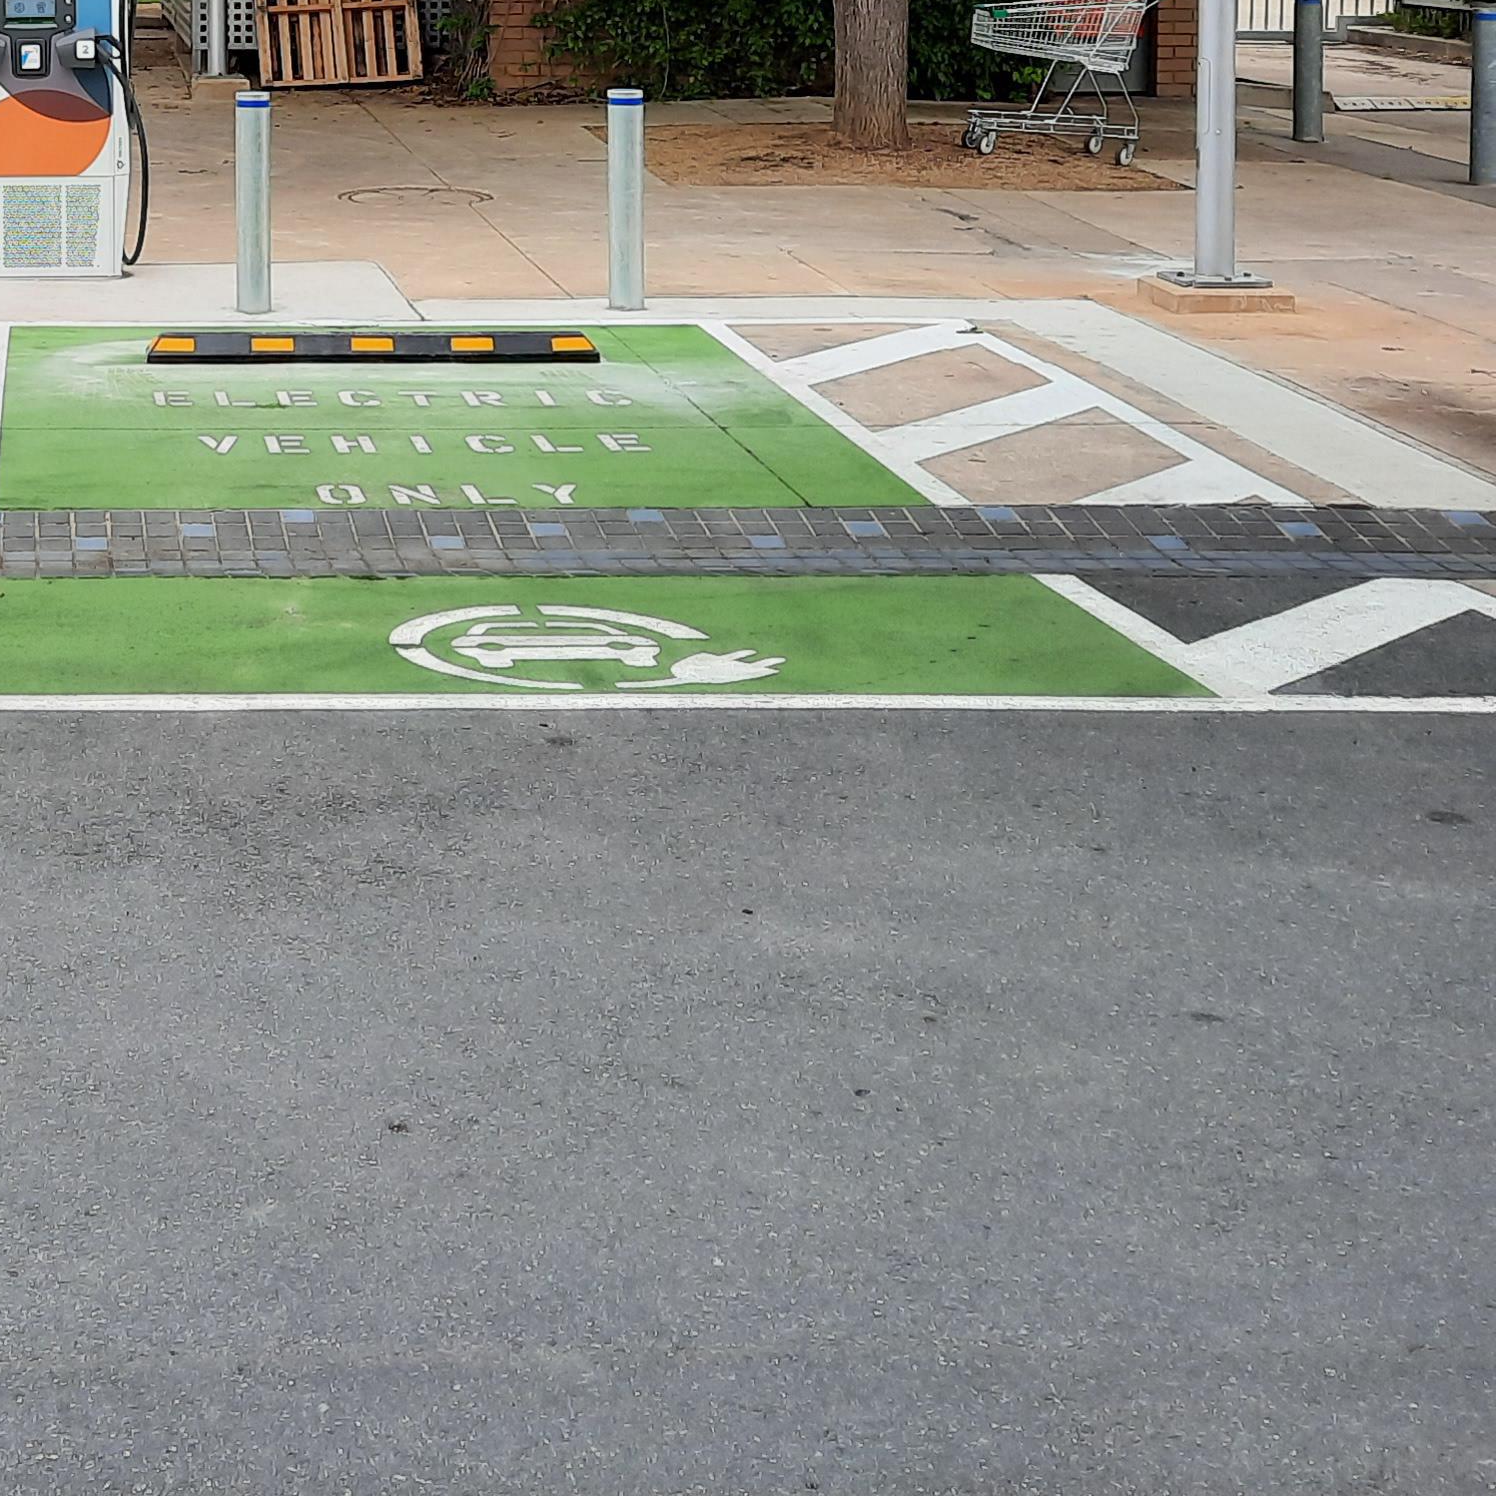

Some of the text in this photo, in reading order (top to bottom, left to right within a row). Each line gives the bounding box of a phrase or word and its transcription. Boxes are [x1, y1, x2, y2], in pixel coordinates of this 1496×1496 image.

[82, 45, 89, 54] 2
[152, 390, 635, 408] ELECTRIC
[197, 433, 653, 455] VEHICLE
[315, 483, 578, 506] ONLY
